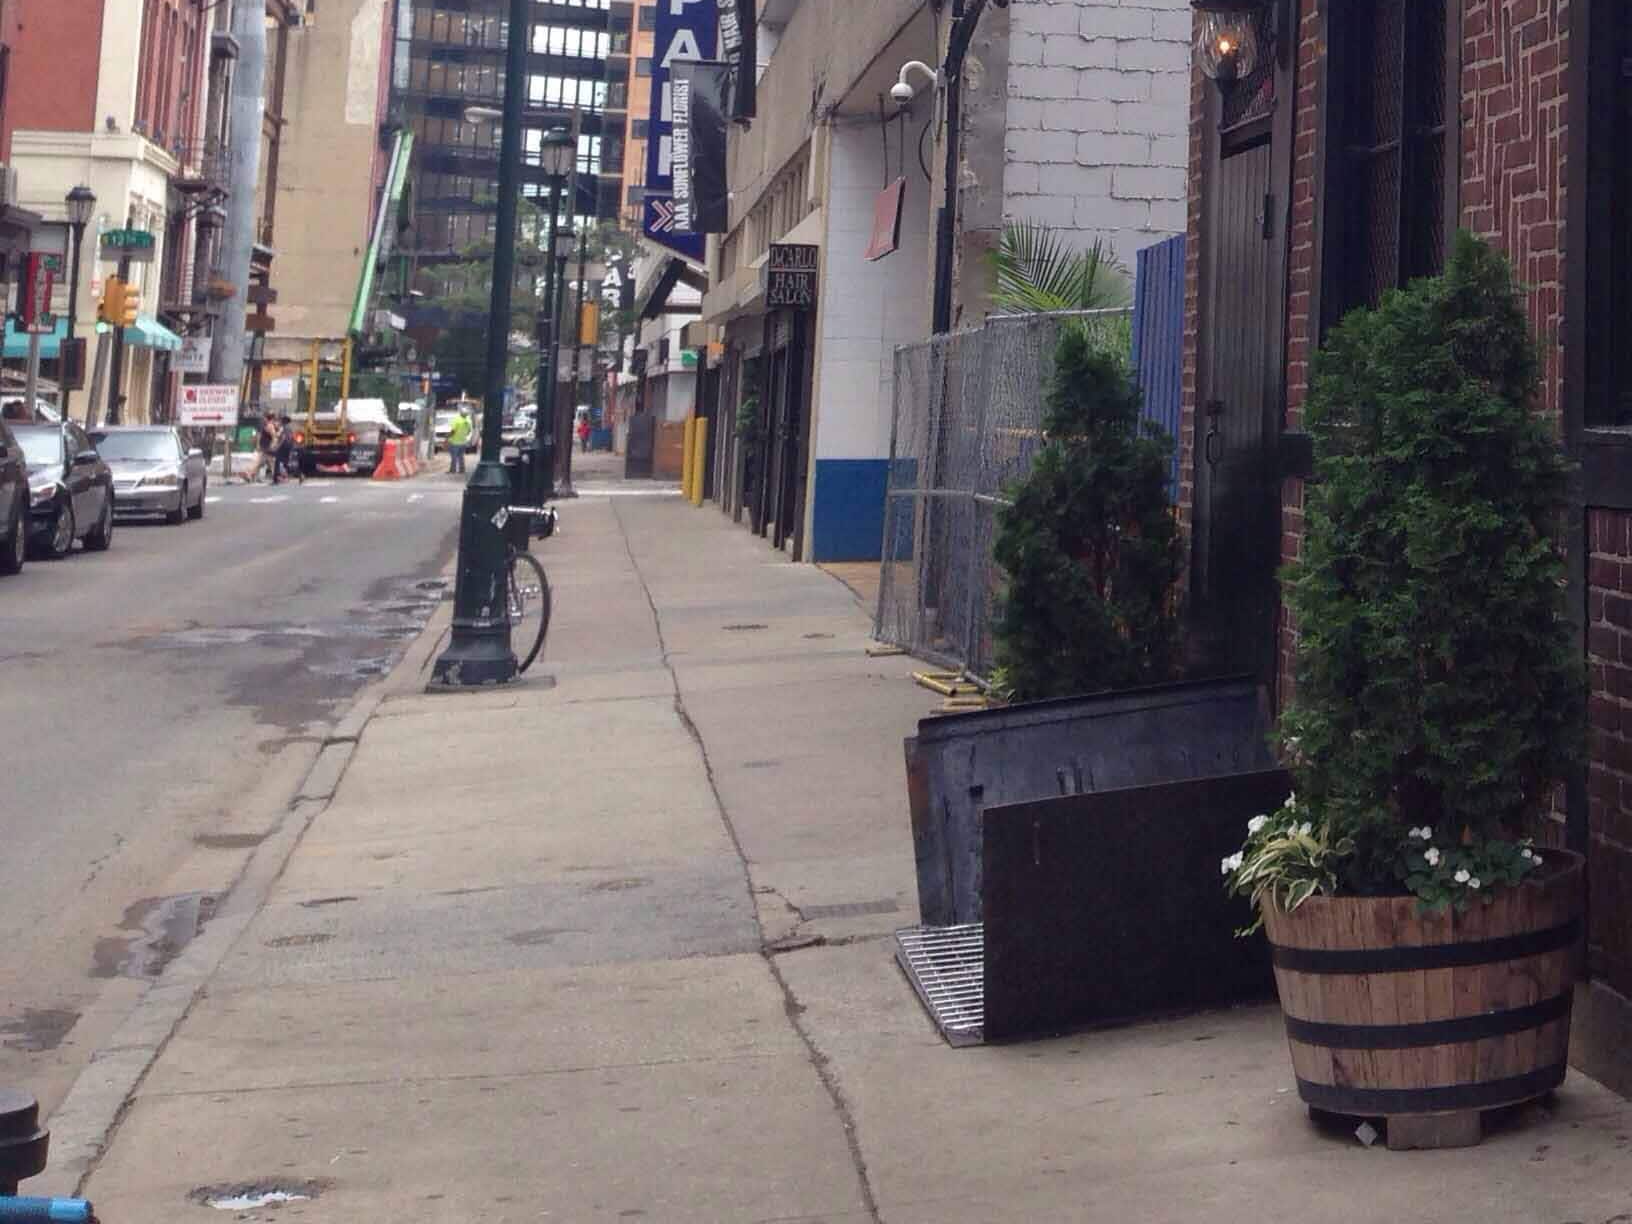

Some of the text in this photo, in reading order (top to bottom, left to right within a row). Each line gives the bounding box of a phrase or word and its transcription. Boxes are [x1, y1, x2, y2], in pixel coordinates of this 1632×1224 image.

[672, 79, 689, 123] FLORIST
[672, 128, 689, 199] SUNFLOWER
[775, 272, 808, 289] HAIR
